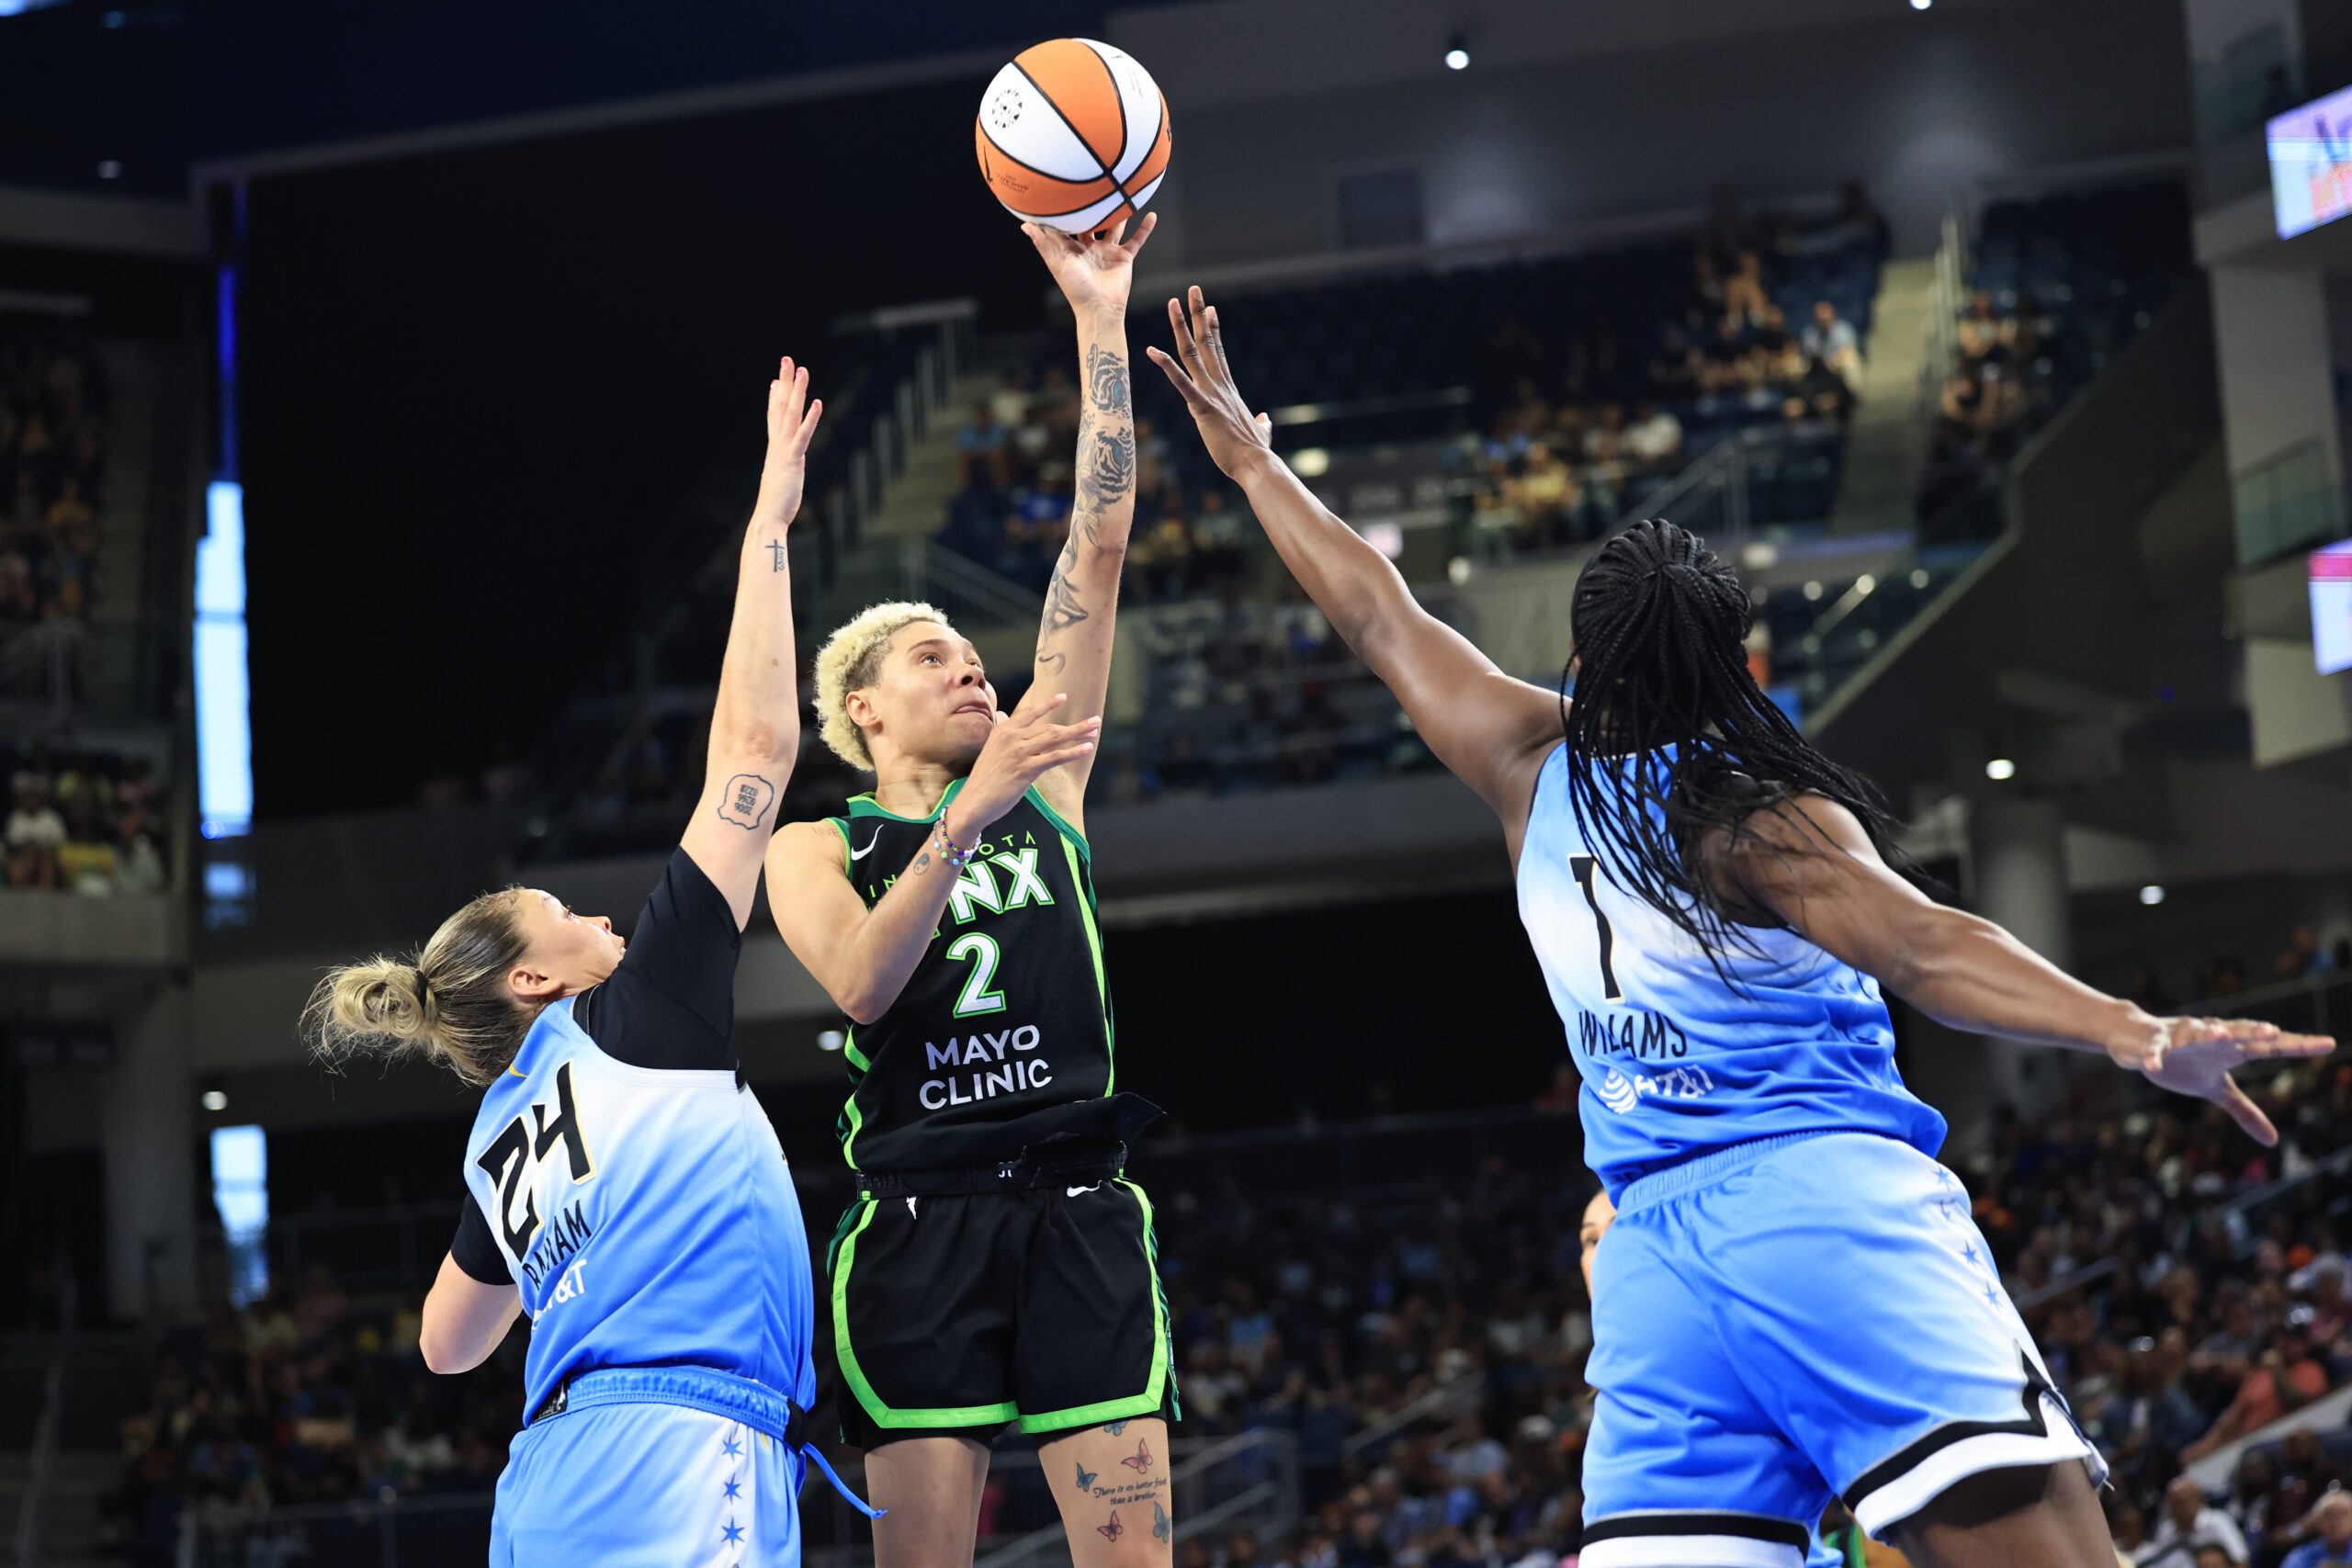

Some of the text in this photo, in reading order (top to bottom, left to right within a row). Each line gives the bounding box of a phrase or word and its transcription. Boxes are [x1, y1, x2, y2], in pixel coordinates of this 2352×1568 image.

[947, 848, 1056, 926] NX
[1566, 852, 1625, 1004] 1
[946, 931, 1007, 1020] 2
[919, 1058, 1053, 1111] CLINIC
[925, 1024, 1041, 1071] MAYO
[476, 1058, 597, 1264] 24
